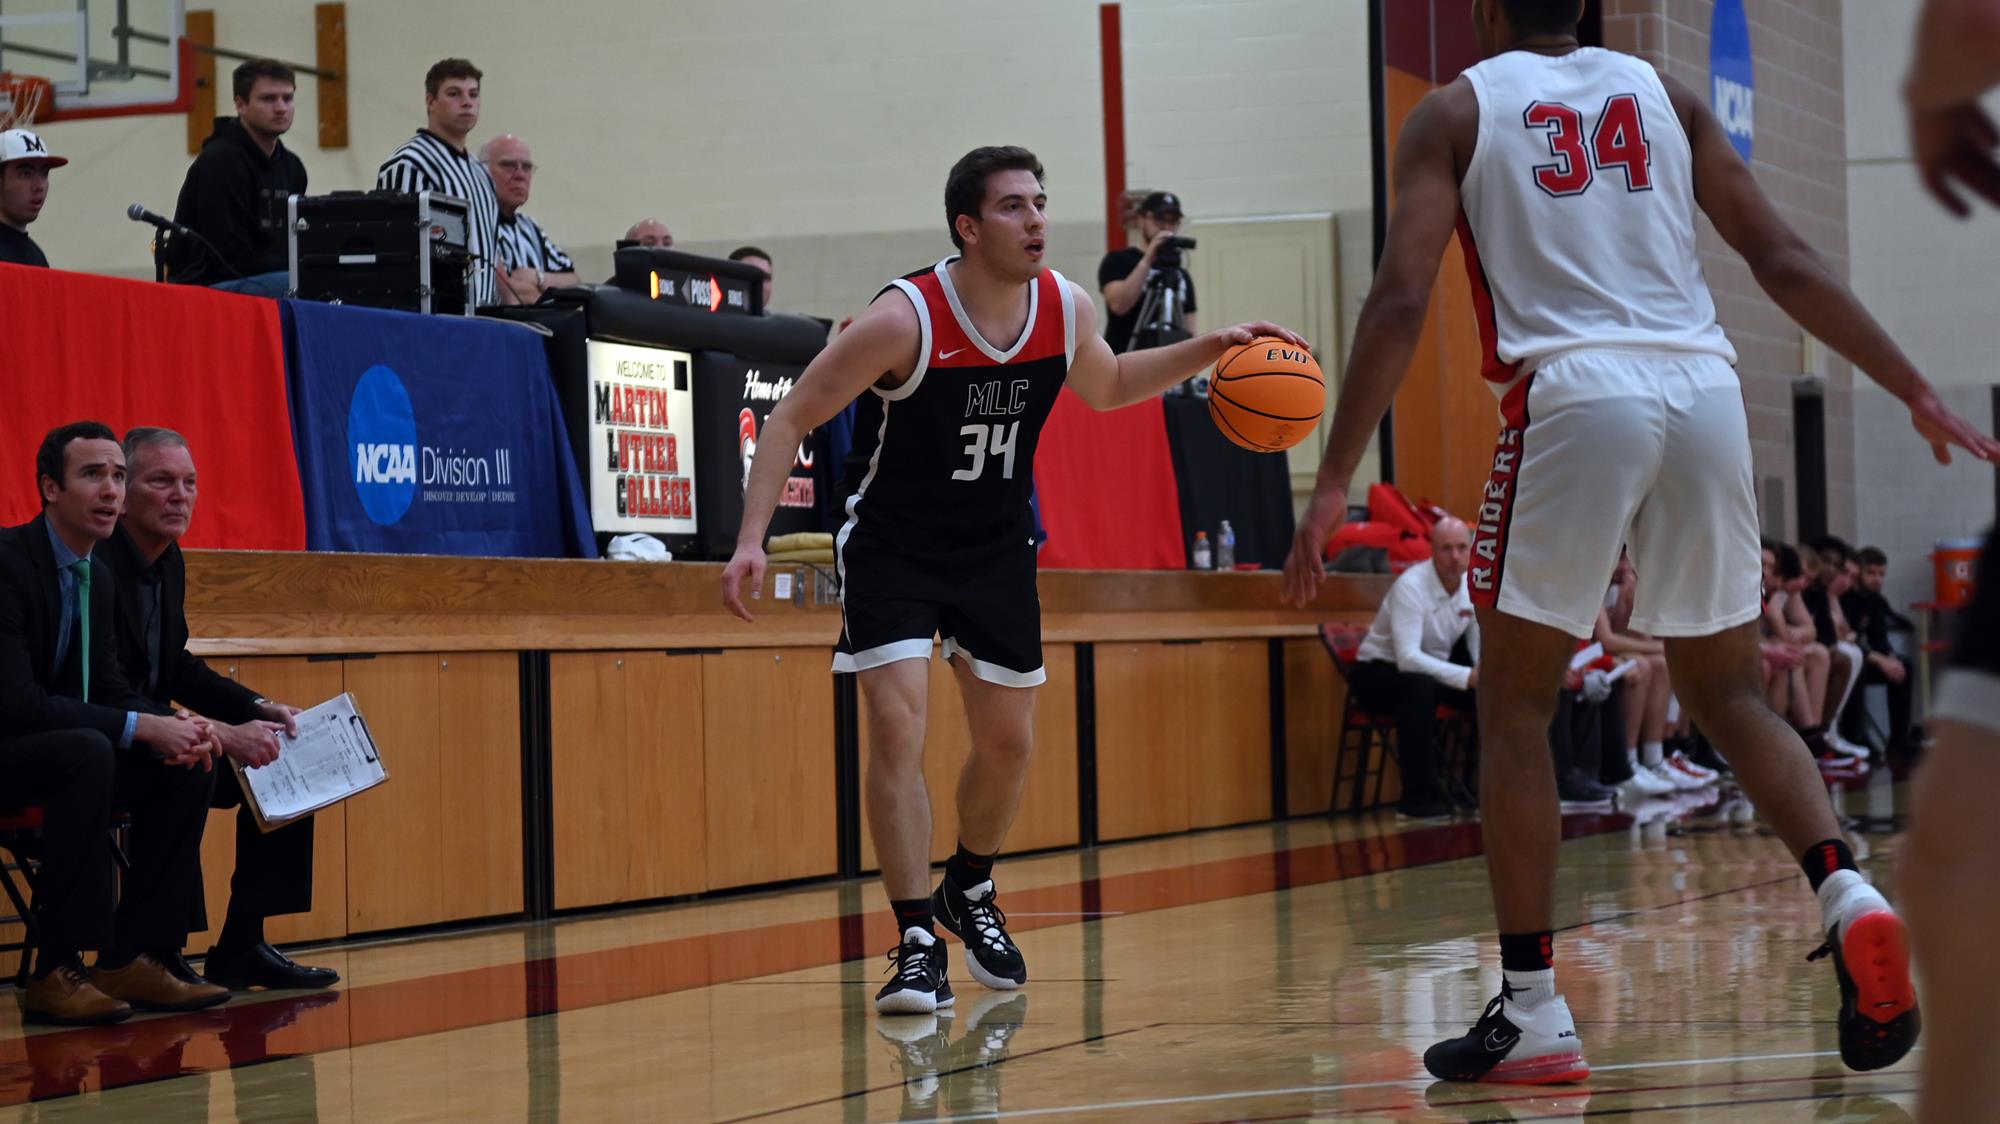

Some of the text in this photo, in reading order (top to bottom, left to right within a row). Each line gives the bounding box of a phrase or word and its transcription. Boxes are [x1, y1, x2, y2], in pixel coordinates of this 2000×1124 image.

[1715, 74, 1754, 139] NCAA
[20, 134, 46, 153] M
[1523, 93, 1653, 198] 34
[616, 360, 666, 381] WELCOME TO
[594, 380, 669, 430] MARTIN
[965, 379, 1029, 418] MLC
[356, 442, 511, 486] NCAA Division III
[606, 428, 679, 475] LUTHER
[951, 420, 1020, 482] 34
[616, 474, 692, 520] COLLEGE
